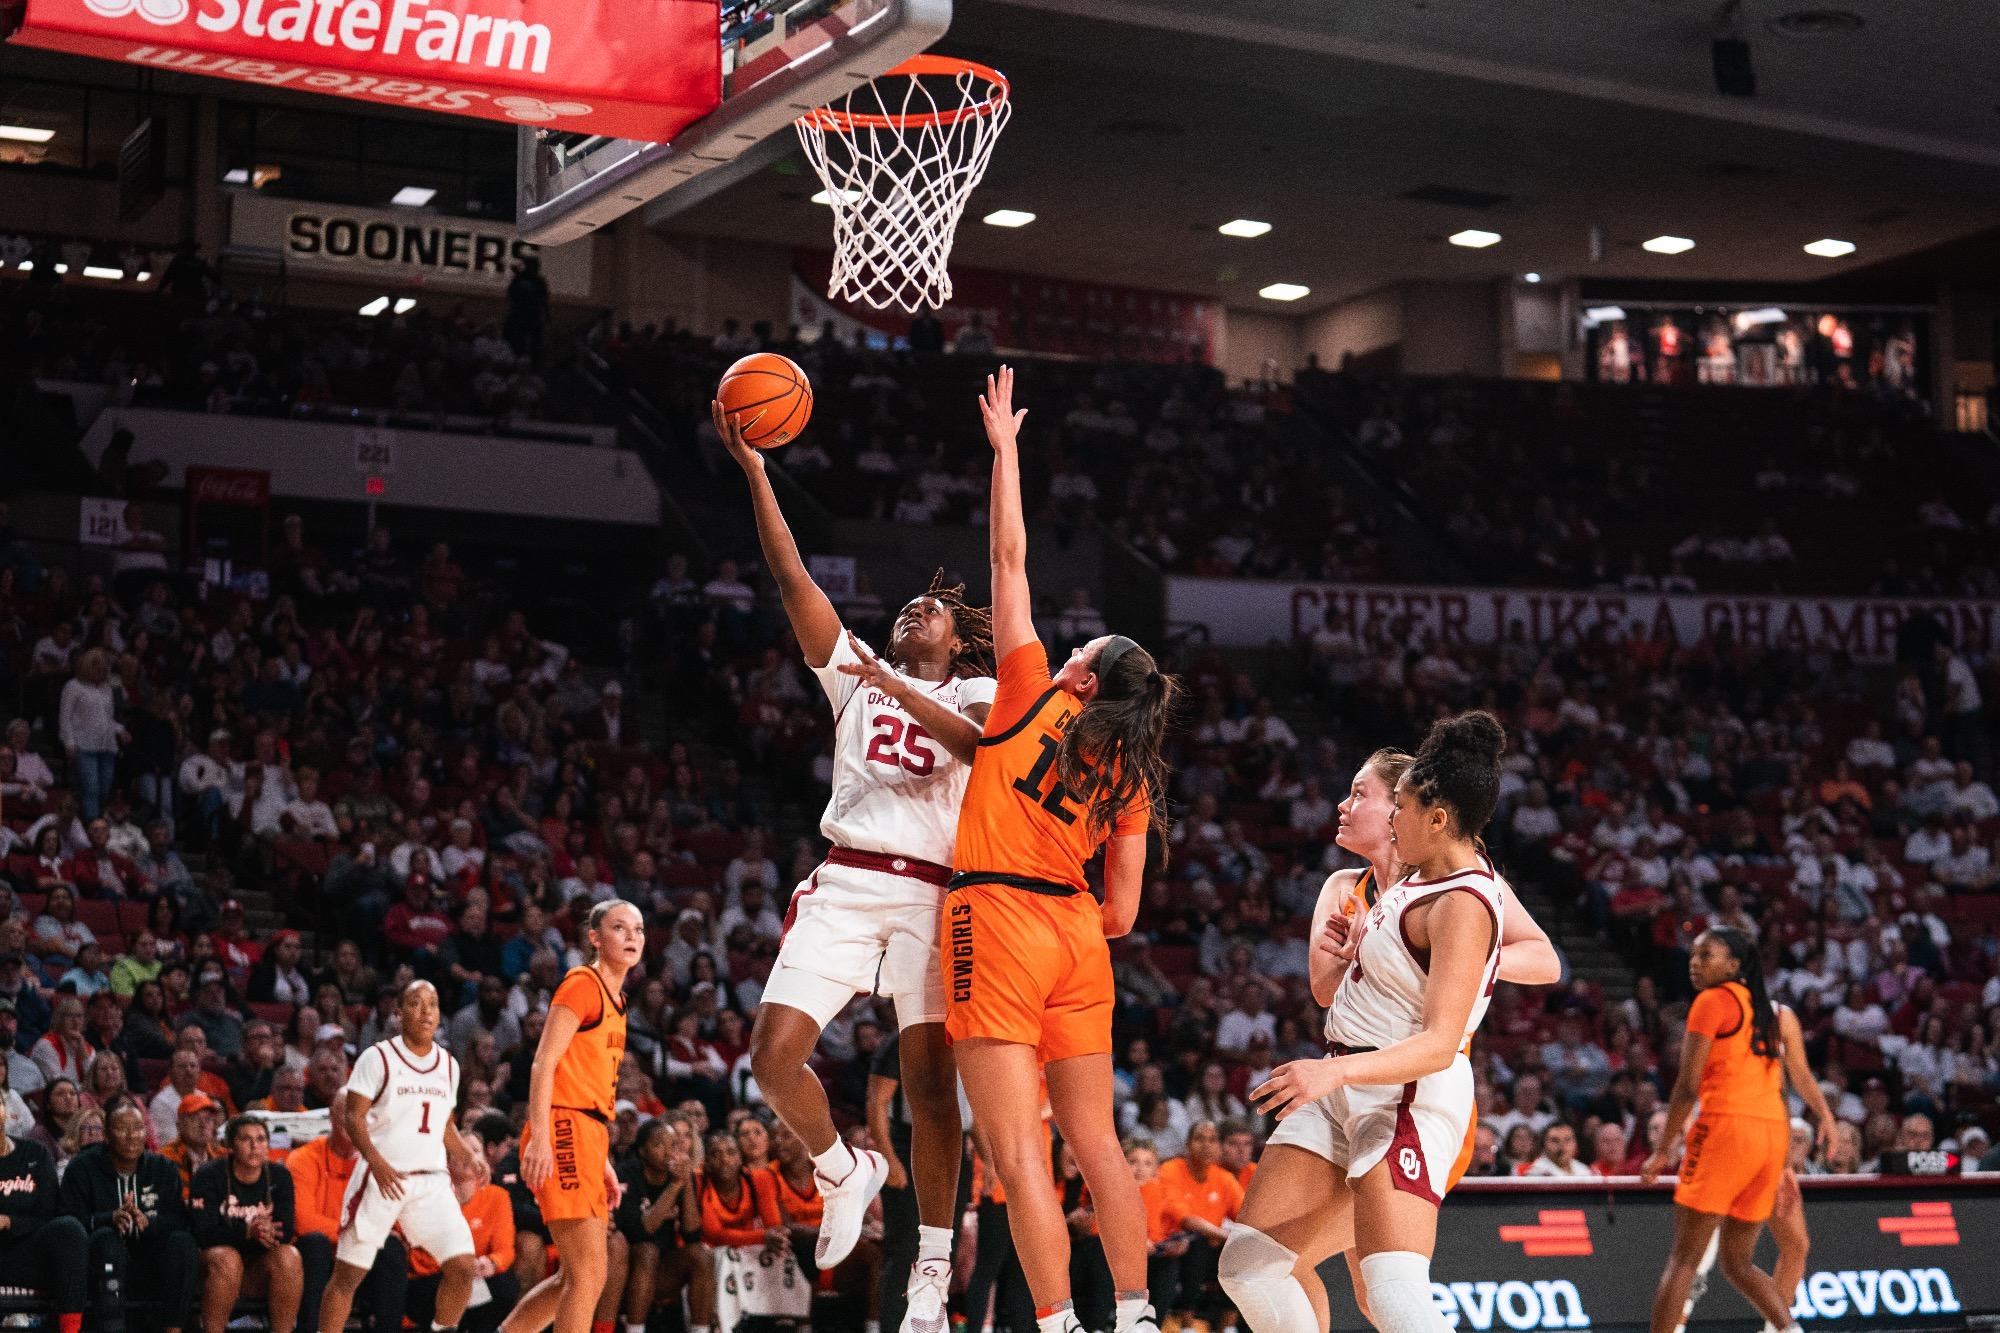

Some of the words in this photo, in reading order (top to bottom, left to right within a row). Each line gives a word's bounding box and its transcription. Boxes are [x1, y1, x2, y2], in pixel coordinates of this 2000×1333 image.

[290, 214, 539, 273] SOONERS
[358, 443, 390, 465] 221
[89, 516, 118, 537] 121
[1293, 588, 1471, 647] CHEER
[1491, 594, 1629, 650] LIKE
[1651, 599, 1681, 650] A
[1703, 601, 1994, 656] CHAMPN
[866, 714, 935, 777] 25
[951, 903, 974, 1003] COWGIRLS
[418, 1101, 430, 1134] 1
[554, 1118, 580, 1191] COWGIRLS
[1400, 1147, 1421, 1181] OU
